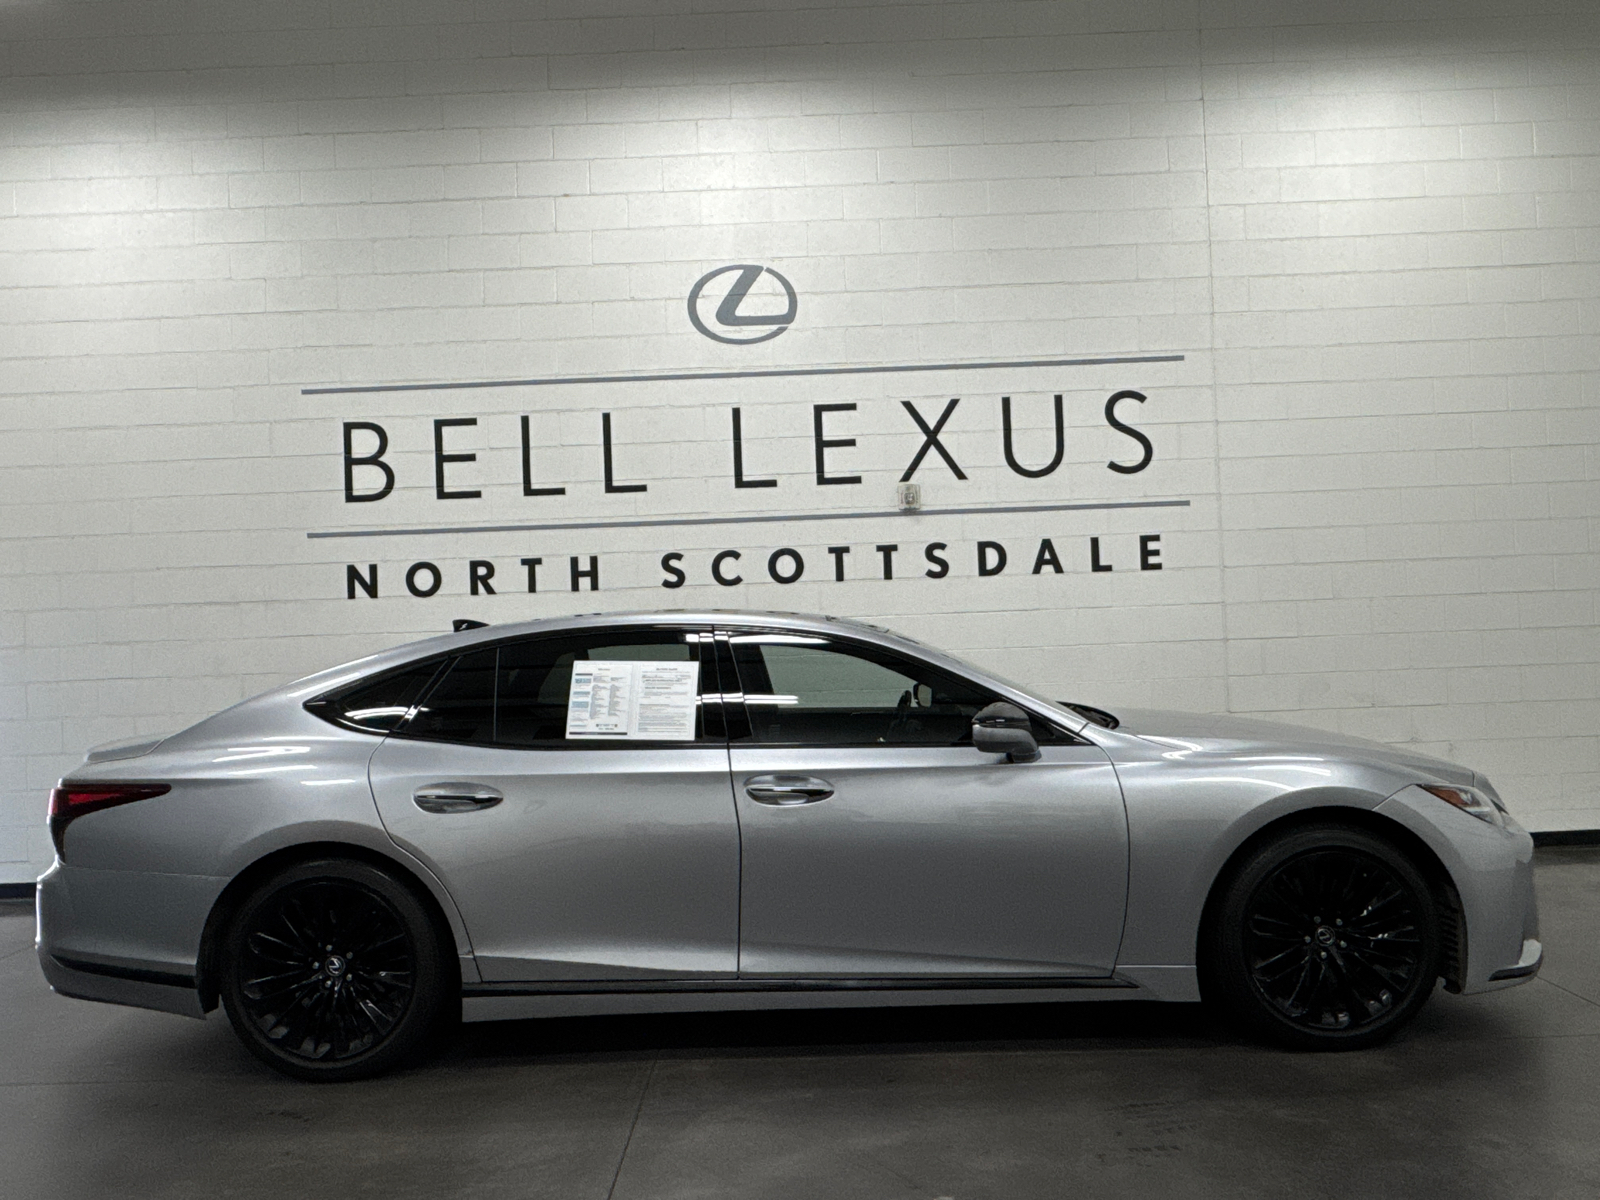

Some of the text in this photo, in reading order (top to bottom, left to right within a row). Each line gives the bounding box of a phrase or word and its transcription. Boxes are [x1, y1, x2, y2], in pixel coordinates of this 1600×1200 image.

[342, 389, 1154, 503] BELL LEXUS
[345, 533, 1164, 601] NORTH SCOTTSDALE
